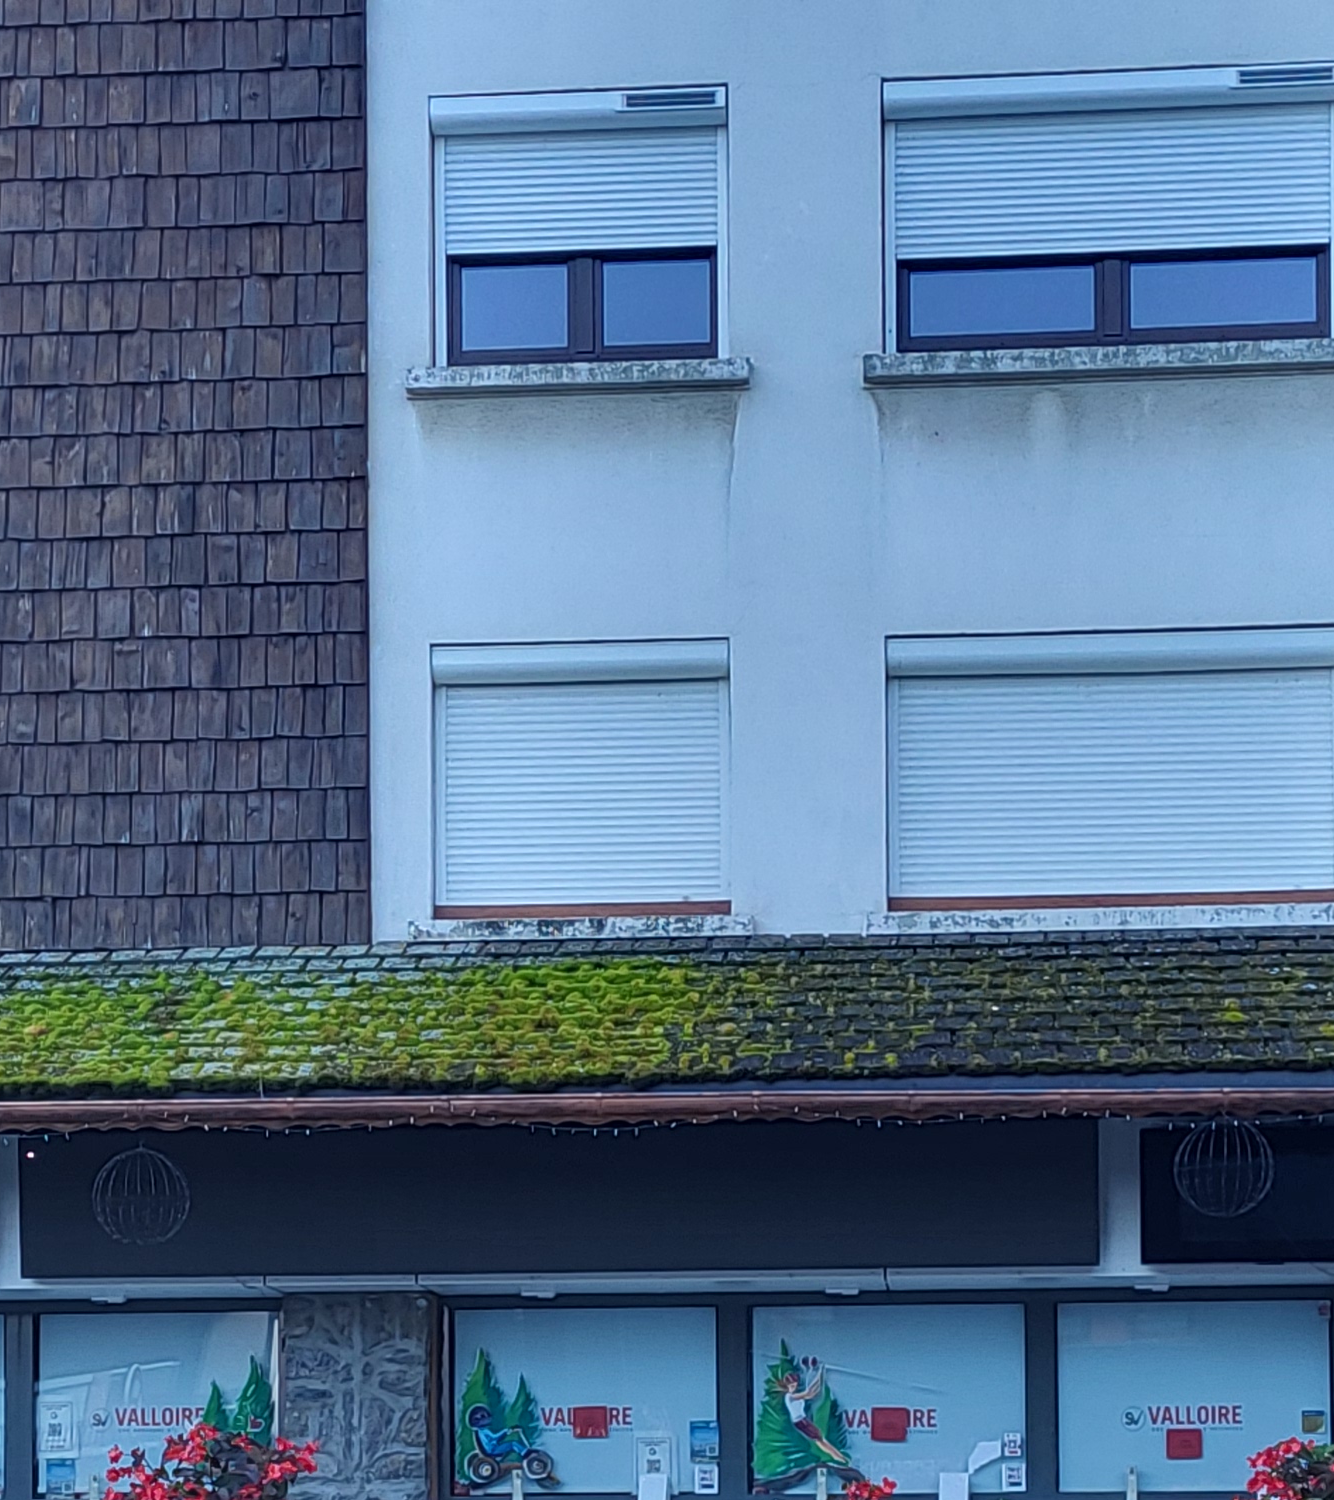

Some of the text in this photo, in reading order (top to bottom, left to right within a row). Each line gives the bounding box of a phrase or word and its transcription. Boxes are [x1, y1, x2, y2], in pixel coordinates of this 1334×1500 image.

[540, 1407, 633, 1426] VALRE
[843, 1408, 937, 1428] VAIRE
[1148, 1405, 1243, 1425] VALLOIRE
